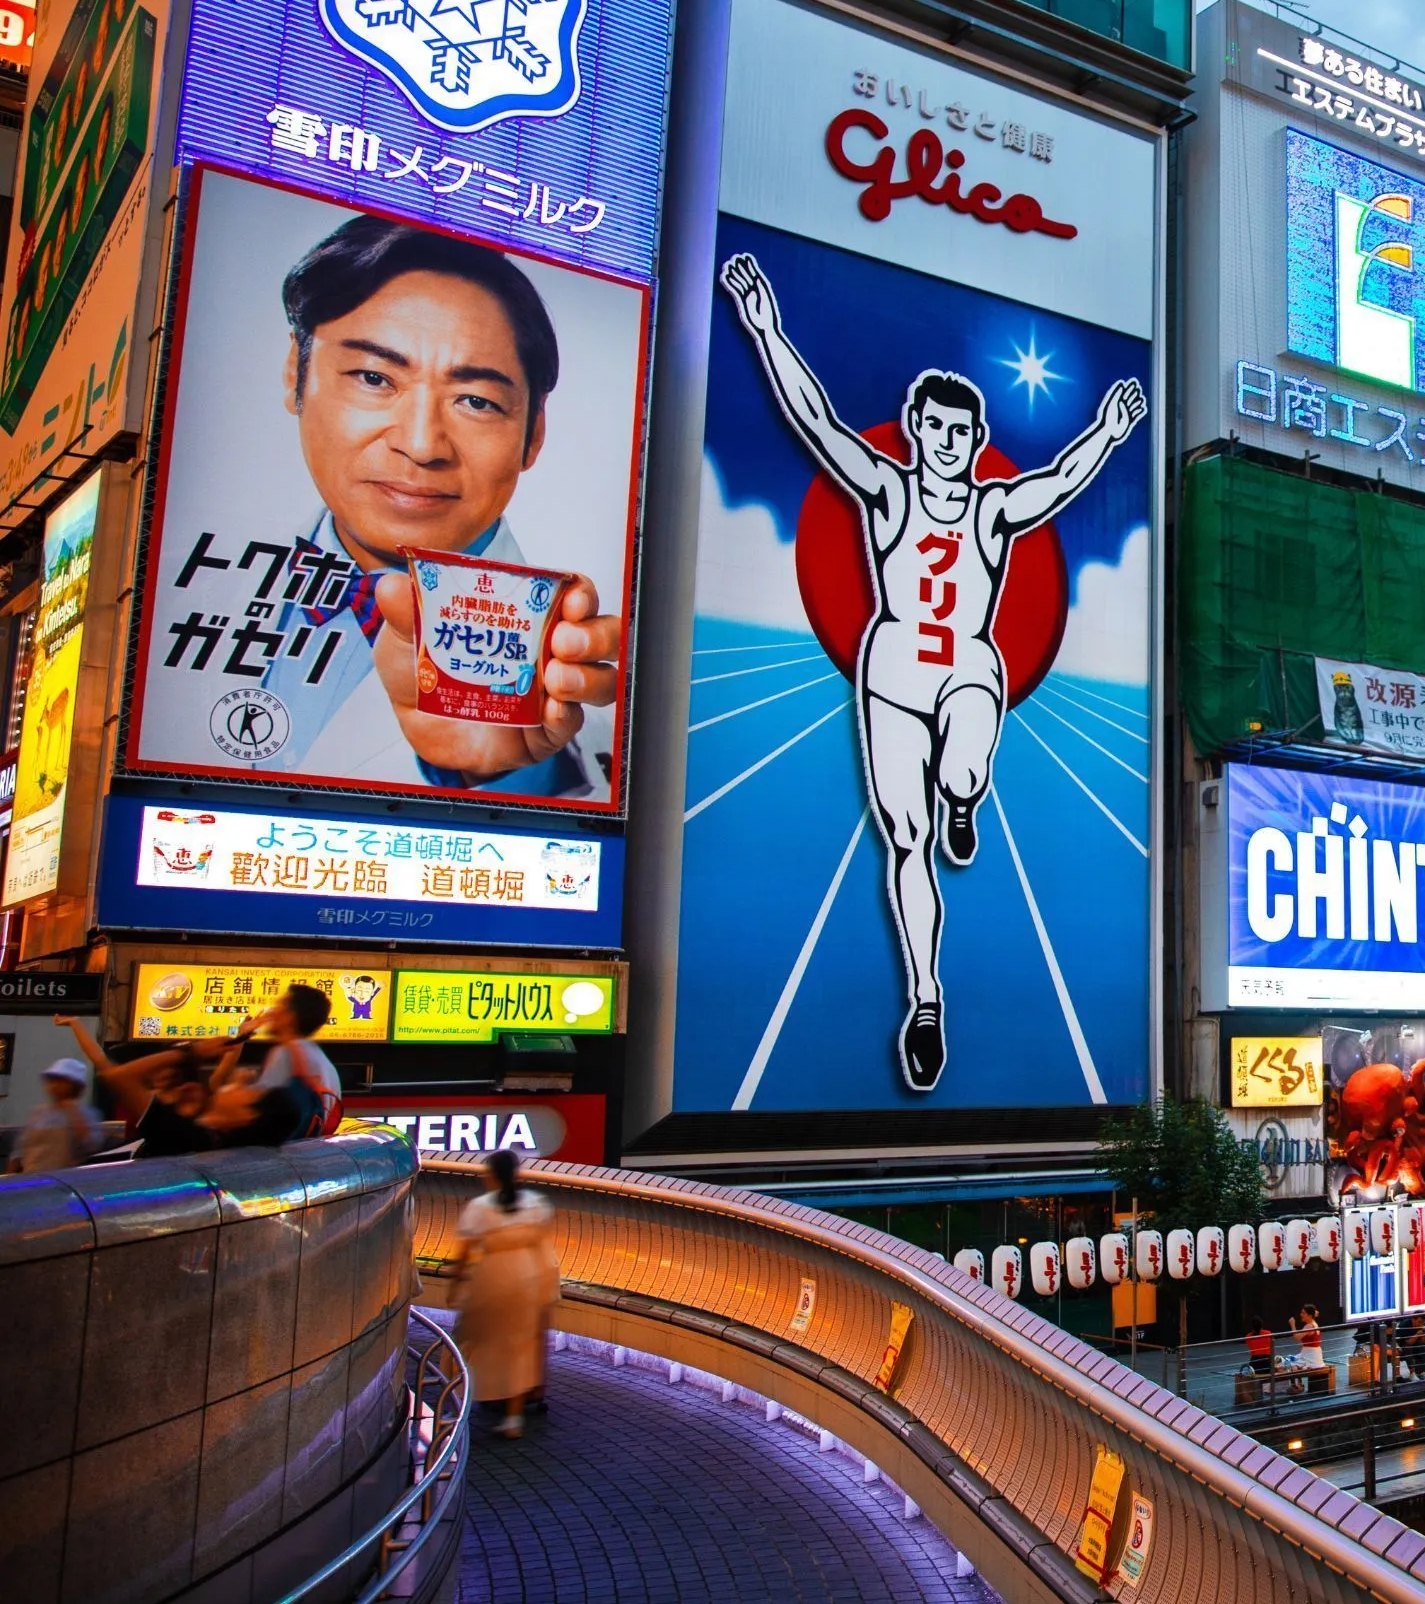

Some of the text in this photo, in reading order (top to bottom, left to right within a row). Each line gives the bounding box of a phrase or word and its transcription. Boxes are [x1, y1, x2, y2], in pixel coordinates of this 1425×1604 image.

[1302, 38, 1424, 112] 夢ある住まい
[852, 67, 1056, 164] おいしさと健康
[266, 104, 608, 234] 雪印メグミルク
[825, 108, 1079, 240] Glico
[173, 532, 353, 610] トクホ
[474, 573, 495, 594] 恵
[248, 601, 271, 620] の
[915, 530, 963, 667] グリコ
[440, 606, 531, 632] 減らすのを助ける
[163, 611, 343, 685] ガセリ
[450, 657, 509, 677] ヨーグルト
[443, 706, 510, 721] はっ酵乳 100g
[256, 822, 504, 864] ようこそ道頓堀へ
[229, 852, 525, 902] 歡迎光臨 道頓堀
[317, 908, 434, 928] 雪印メグミルク
[0, 978, 67, 997] oilets
[205, 968, 335, 979] KANSAI INVEST CORPORATION
[203, 995, 275, 1006] 居抜き店舗総
[403, 985, 463, 1015] 賃貸・売買
[467, 980, 554, 1021] ピタットハウス
[166, 1025, 220, 1037] 株式会社
[398, 1026, 481, 1035] http://www.pitat.com/
